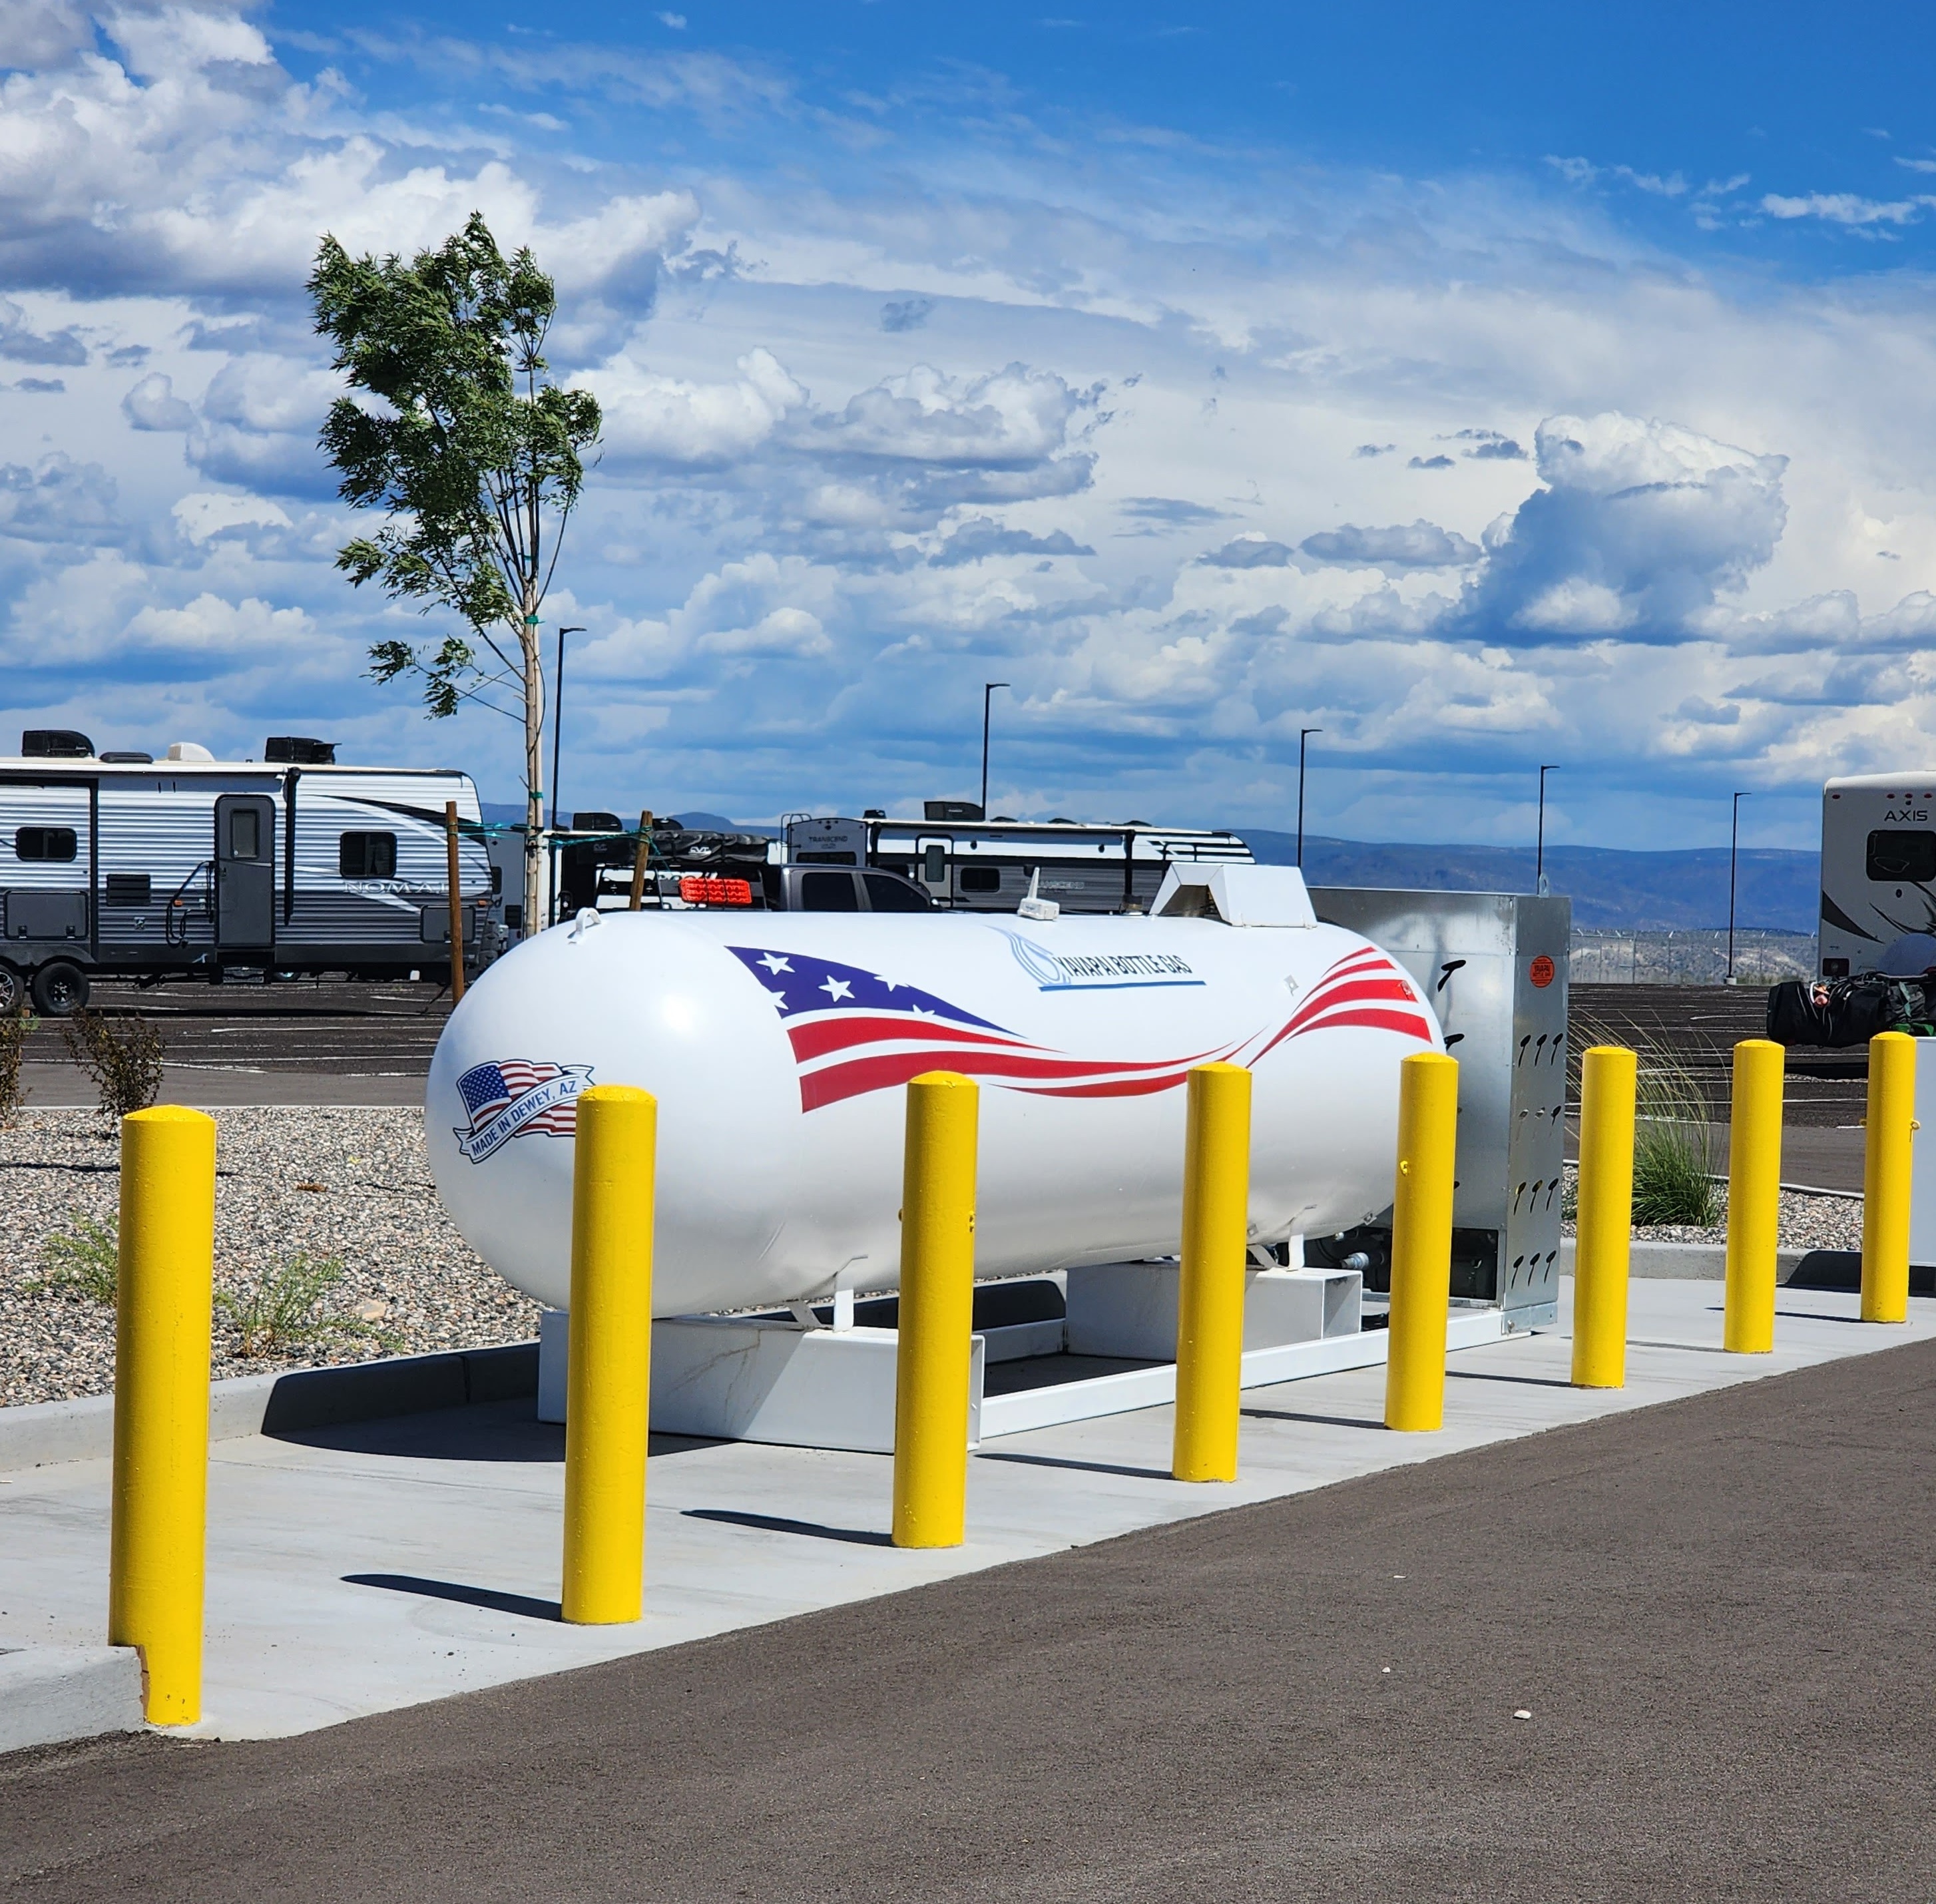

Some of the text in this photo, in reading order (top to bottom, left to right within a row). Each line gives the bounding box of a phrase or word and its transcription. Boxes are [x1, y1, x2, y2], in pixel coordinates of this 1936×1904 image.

[1883, 810, 1928, 822] AXIS
[1052, 955, 1193, 977] YAVAPAI BOTTLE GAS
[471, 1080, 577, 1156] MADE IN DEWEY, AZ
